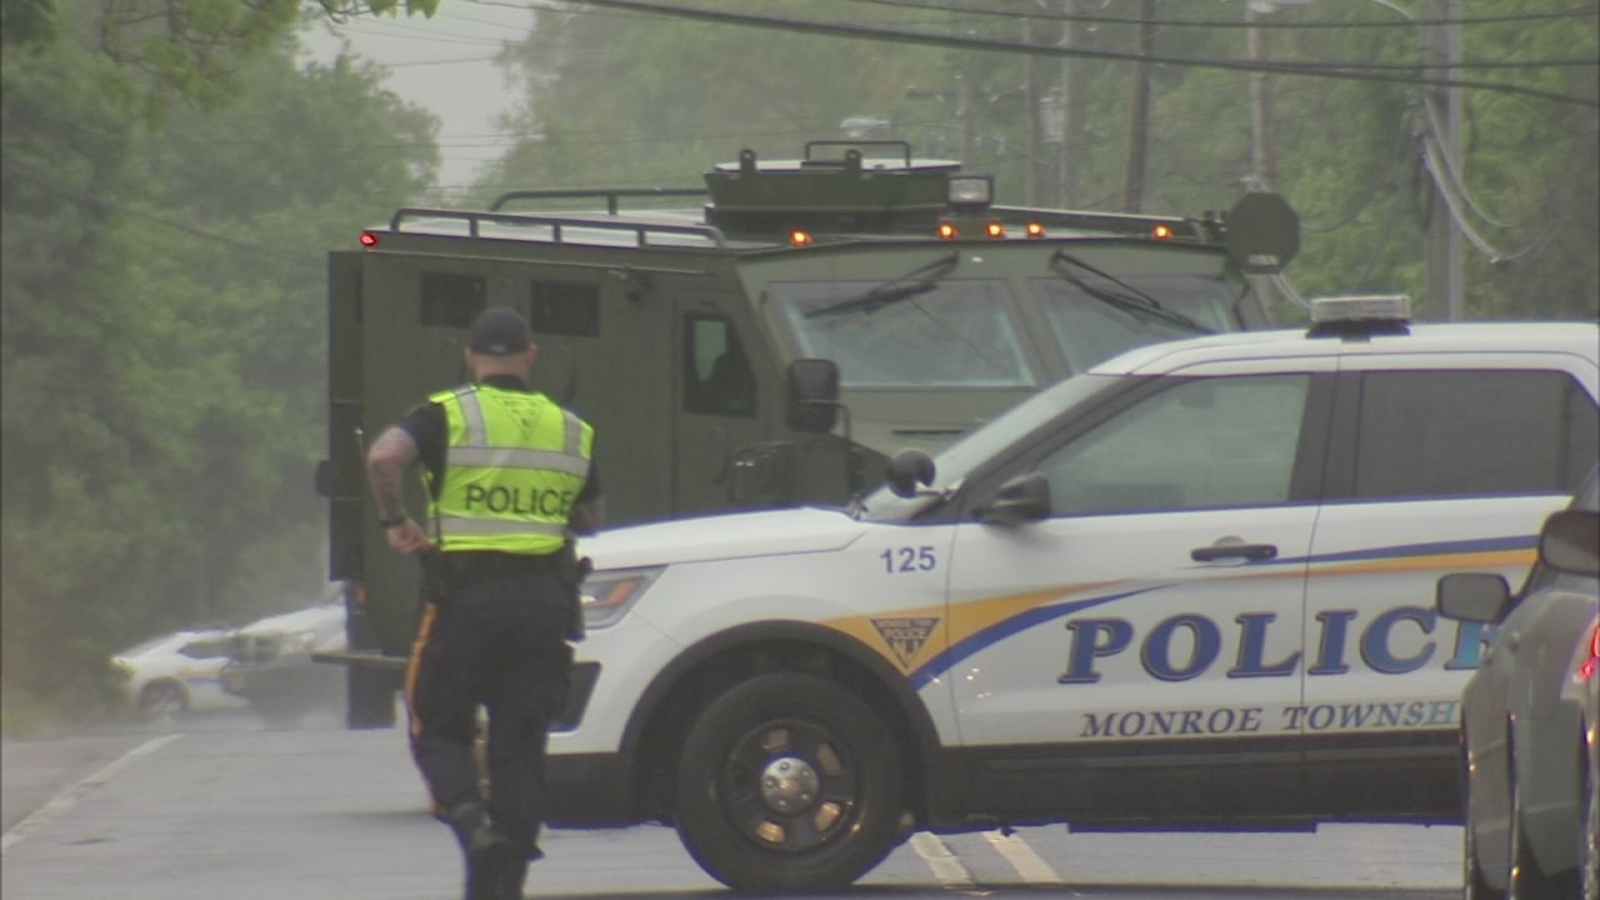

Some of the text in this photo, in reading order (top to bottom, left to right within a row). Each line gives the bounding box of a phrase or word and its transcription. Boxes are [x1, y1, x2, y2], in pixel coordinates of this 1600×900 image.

[465, 484, 572, 516] POLICE
[880, 546, 936, 573] 125
[1080, 700, 1459, 737] MONROE TOWNSH
